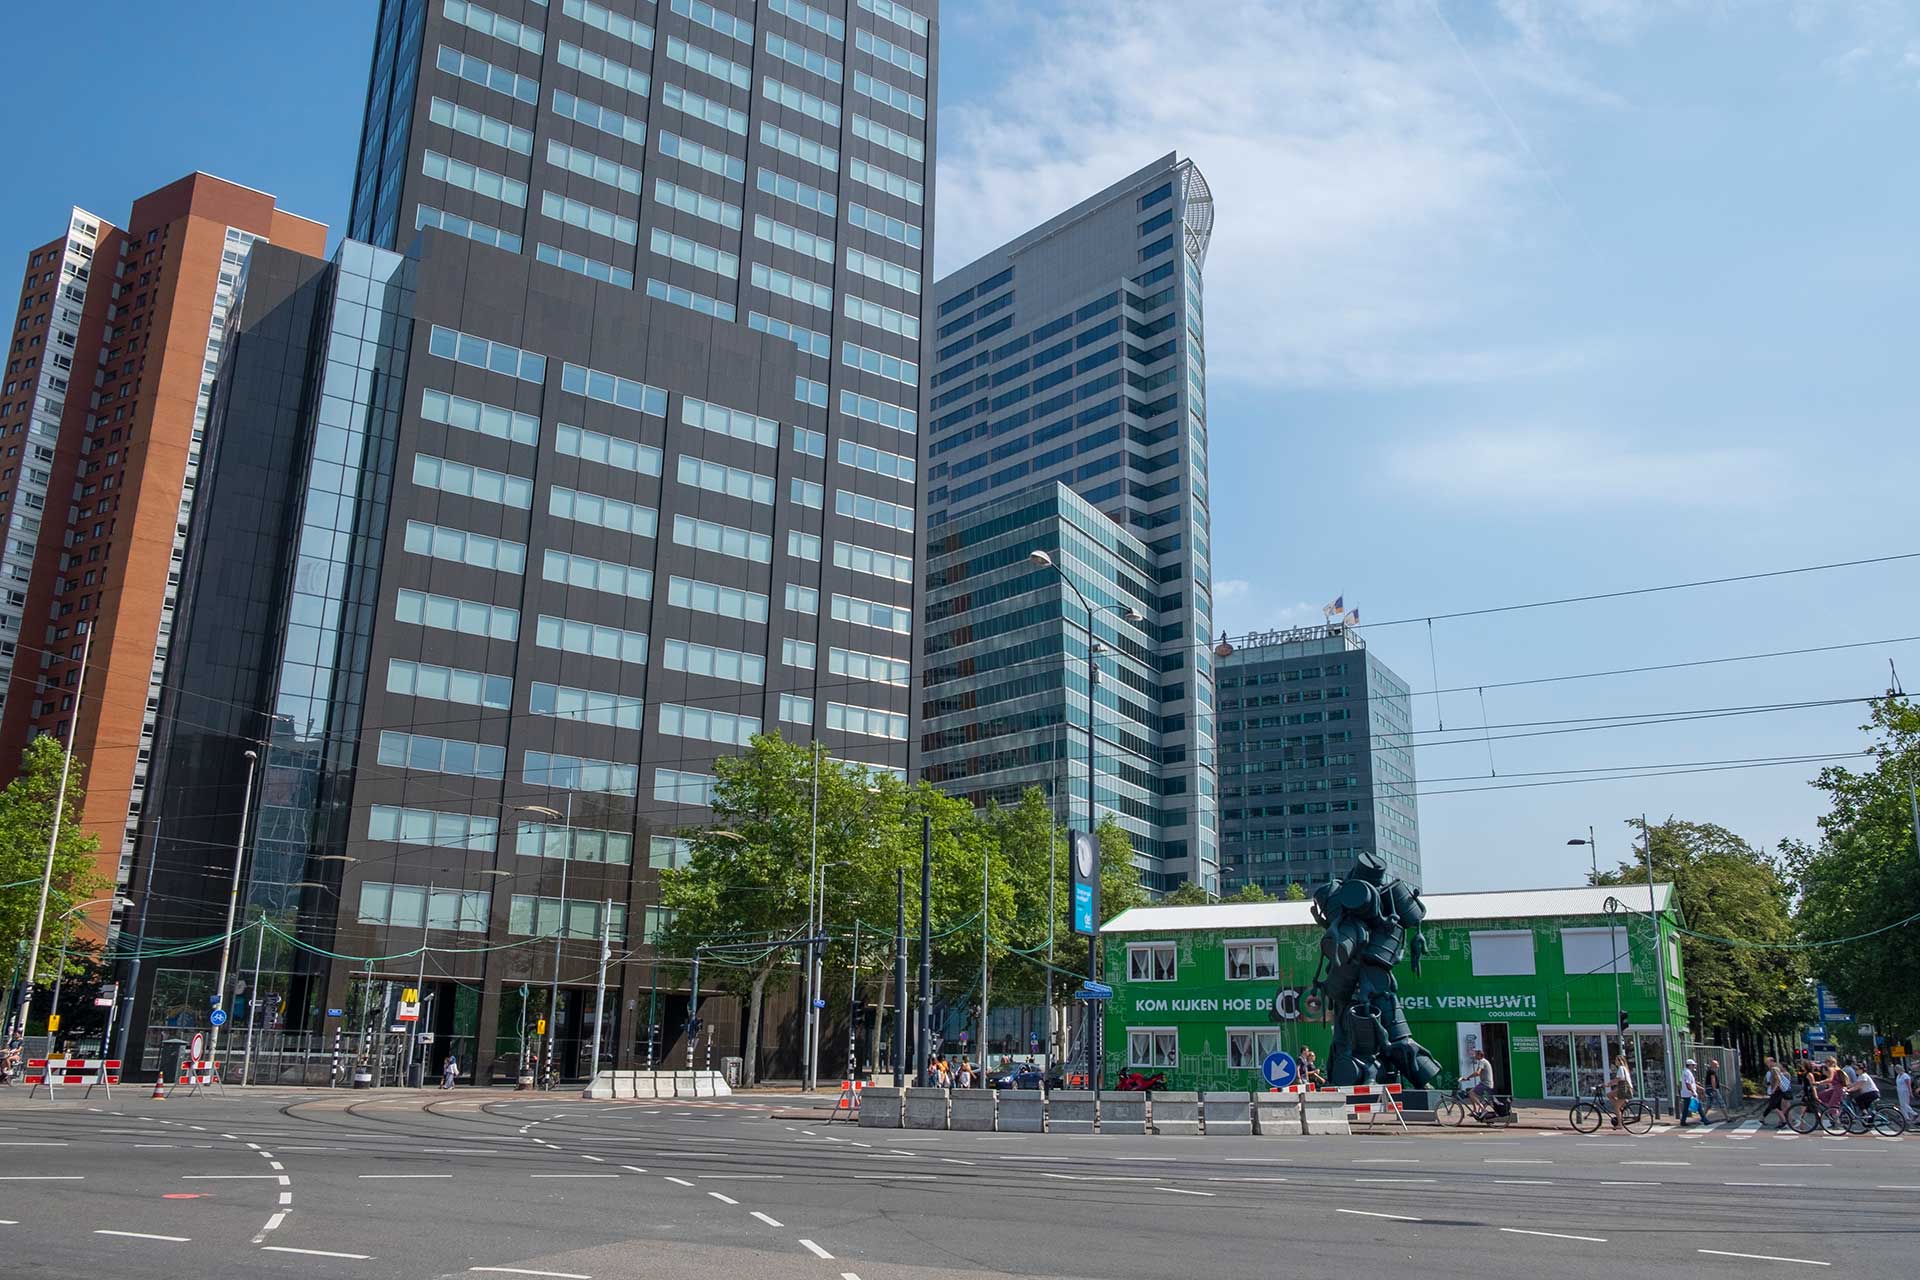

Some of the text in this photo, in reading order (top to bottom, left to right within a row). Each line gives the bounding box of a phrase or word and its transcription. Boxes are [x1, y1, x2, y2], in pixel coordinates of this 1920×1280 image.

[1135, 999, 1168, 1012] KOM
[1172, 998, 1219, 1012] KIJKEN
[1223, 998, 1252, 1011] HOE
[1256, 998, 1273, 1011] DE
[1436, 995, 1537, 1009] VERNIEUWT!
